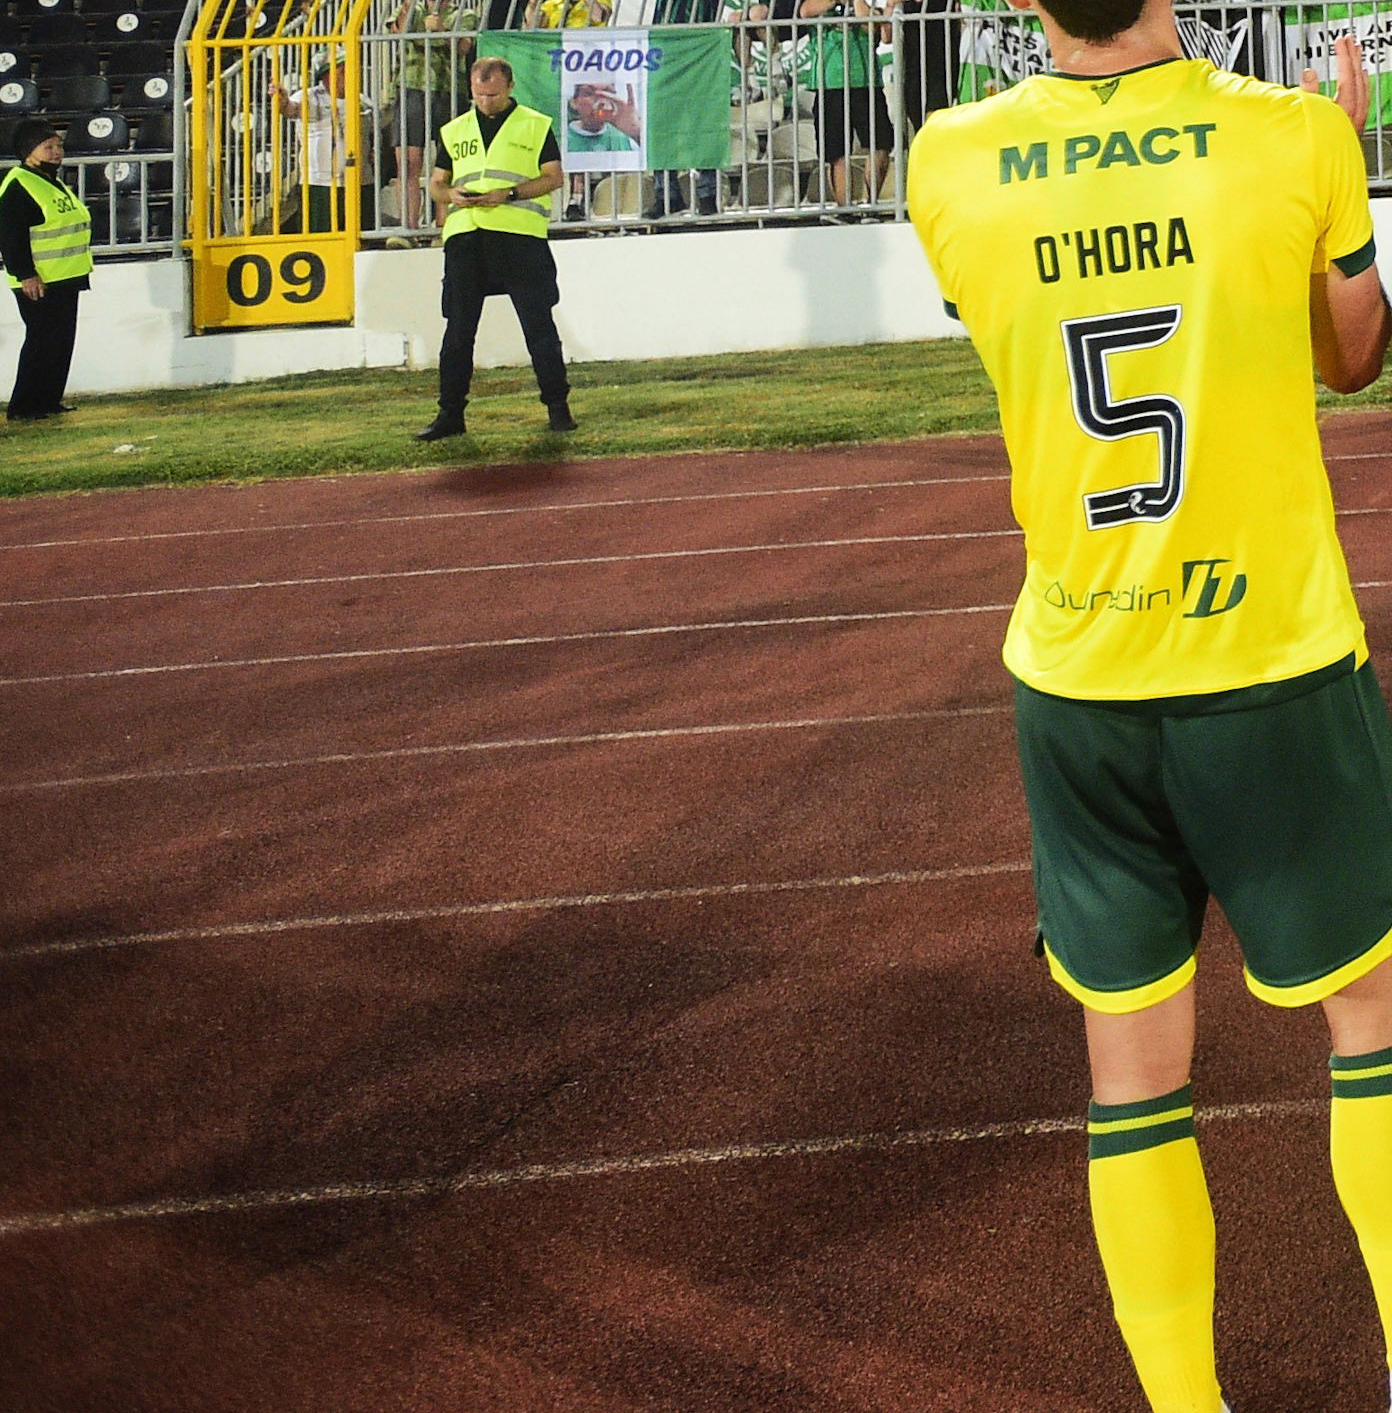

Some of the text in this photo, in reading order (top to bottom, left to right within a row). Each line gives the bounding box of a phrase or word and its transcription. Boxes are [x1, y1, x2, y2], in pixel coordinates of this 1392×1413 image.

[547, 48, 665, 72] TOAODS
[452, 139, 478, 162] 306
[1065, 123, 1217, 174] PACT
[1033, 217, 1196, 284] O'HORA
[226, 251, 326, 307] 09
[1060, 303, 1187, 532] 5
